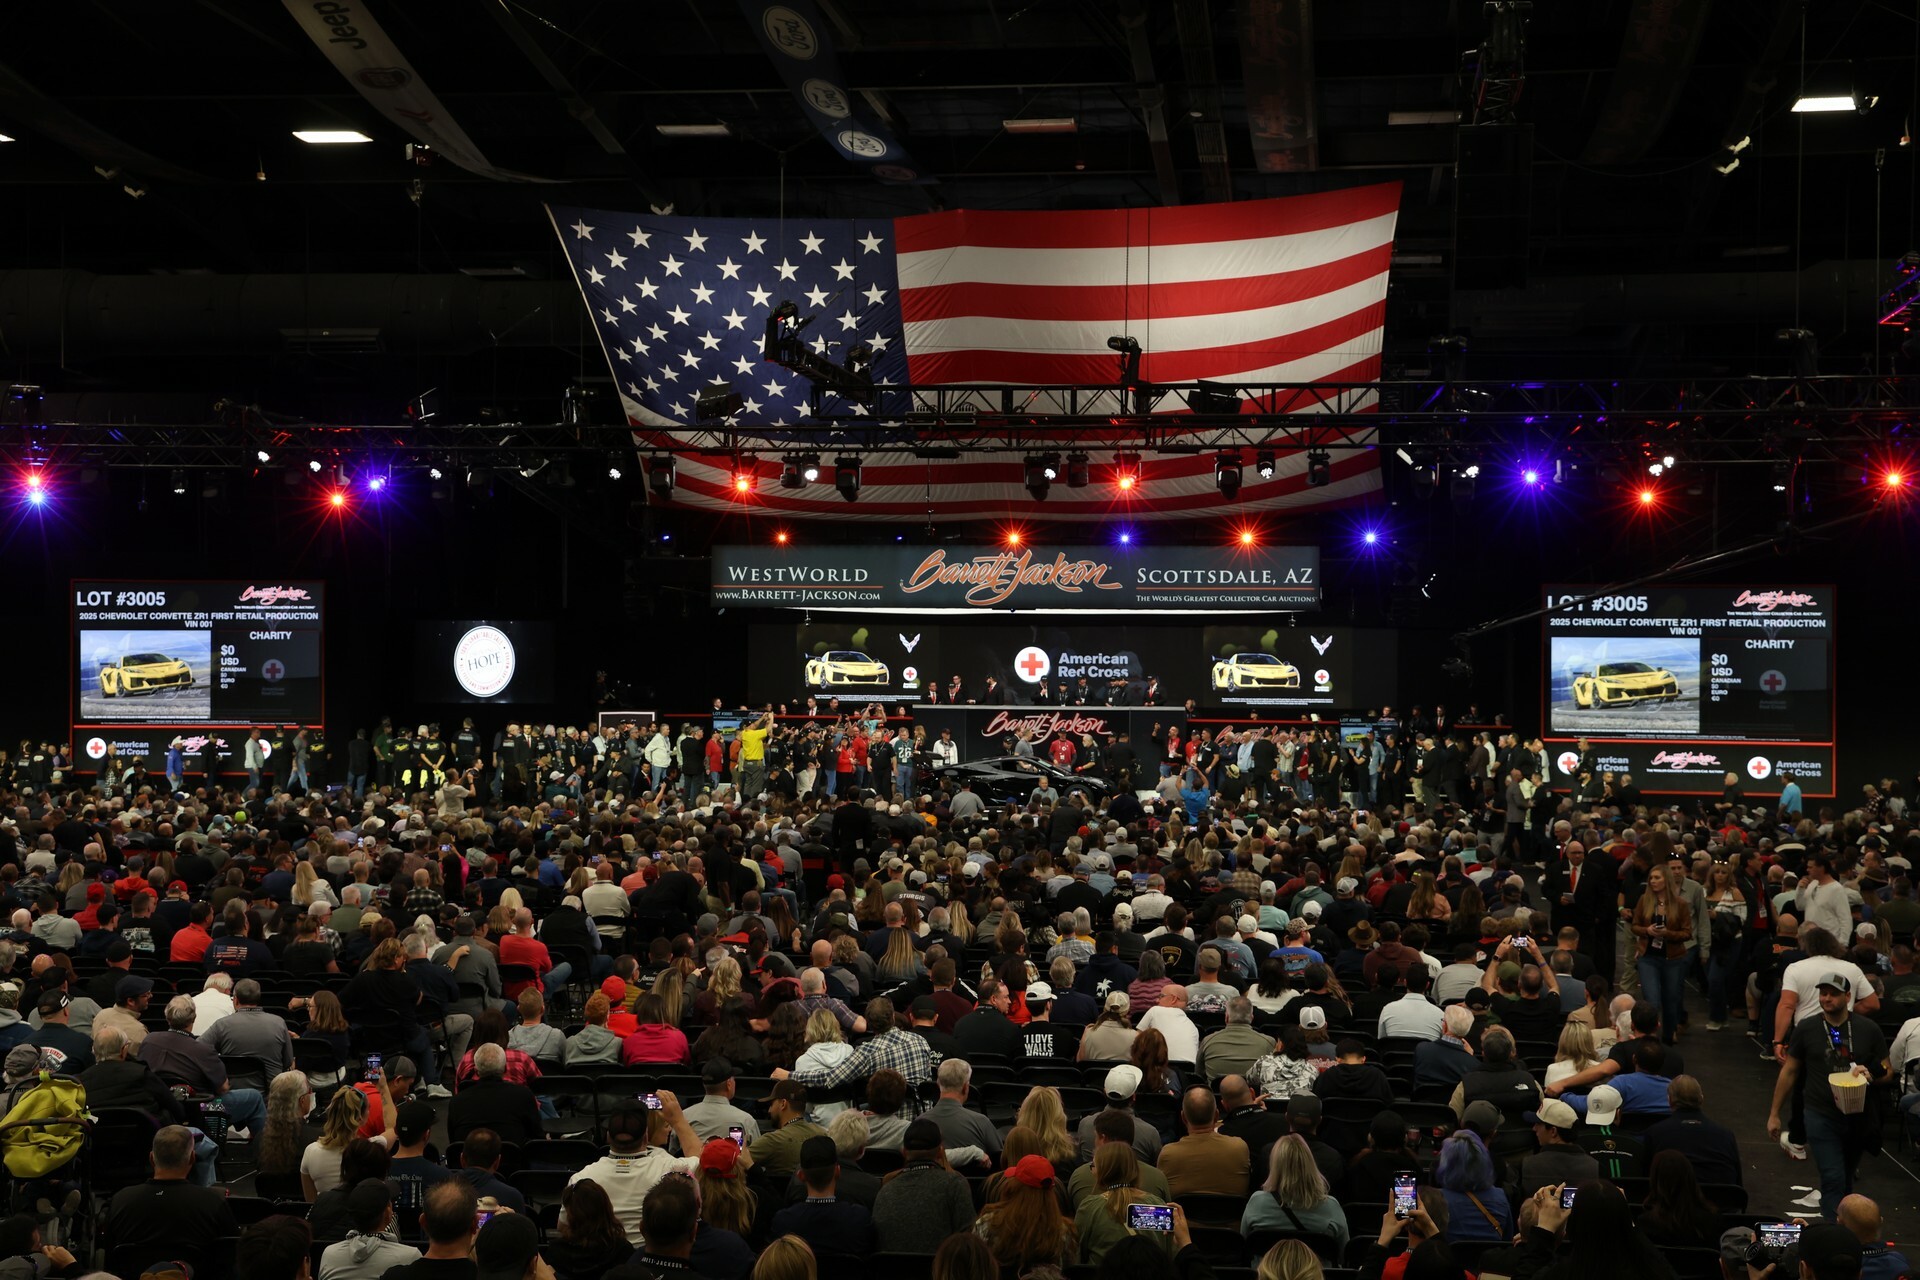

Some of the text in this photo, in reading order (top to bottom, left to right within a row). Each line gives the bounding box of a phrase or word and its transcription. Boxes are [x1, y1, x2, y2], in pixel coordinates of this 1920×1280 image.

[313, 1, 367, 50] Jeep
[774, 19, 810, 50] Ford
[900, 549, 1123, 606] Barrett-Jackson
[1137, 568, 1313, 585] SCOTTSDALE, AZ
[76, 591, 165, 607] LOT #3005
[1592, 595, 1648, 612] #3005
[79, 612, 319, 620] 2025 CHEVROLET CORVETTE ZR1 FIRST RETAIL PRODUCTION
[185, 620, 213, 628] VIN 001
[1550, 618, 1827, 628] 2025 CHEVROLET CORVETTE ZR1 FIRST RETAIL PRODUCTION
[249, 631, 292, 640] CHARITY
[1669, 627, 1702, 636] VIN 001
[1745, 639, 1795, 649] CHARITY
[220, 644, 235, 656] $0
[220, 657, 239, 666] USD
[468, 652, 502, 671] HOPE
[1058, 652, 1129, 664] American
[1711, 654, 1728, 666] $0
[1058, 666, 1129, 678] Red Cross
[1711, 667, 1733, 676] USD
[116, 748, 149, 756] ed Cross
[898, 747, 911, 759] 26
[1597, 755, 1629, 764] erican
[1776, 760, 1822, 769] American
[1603, 764, 1629, 772] Cross
[1795, 769, 1822, 777] Cross
[898, 892, 926, 902] STURGIS
[1030, 1034, 1053, 1044] LOVE
[1024, 1043, 1053, 1053] WALLS
